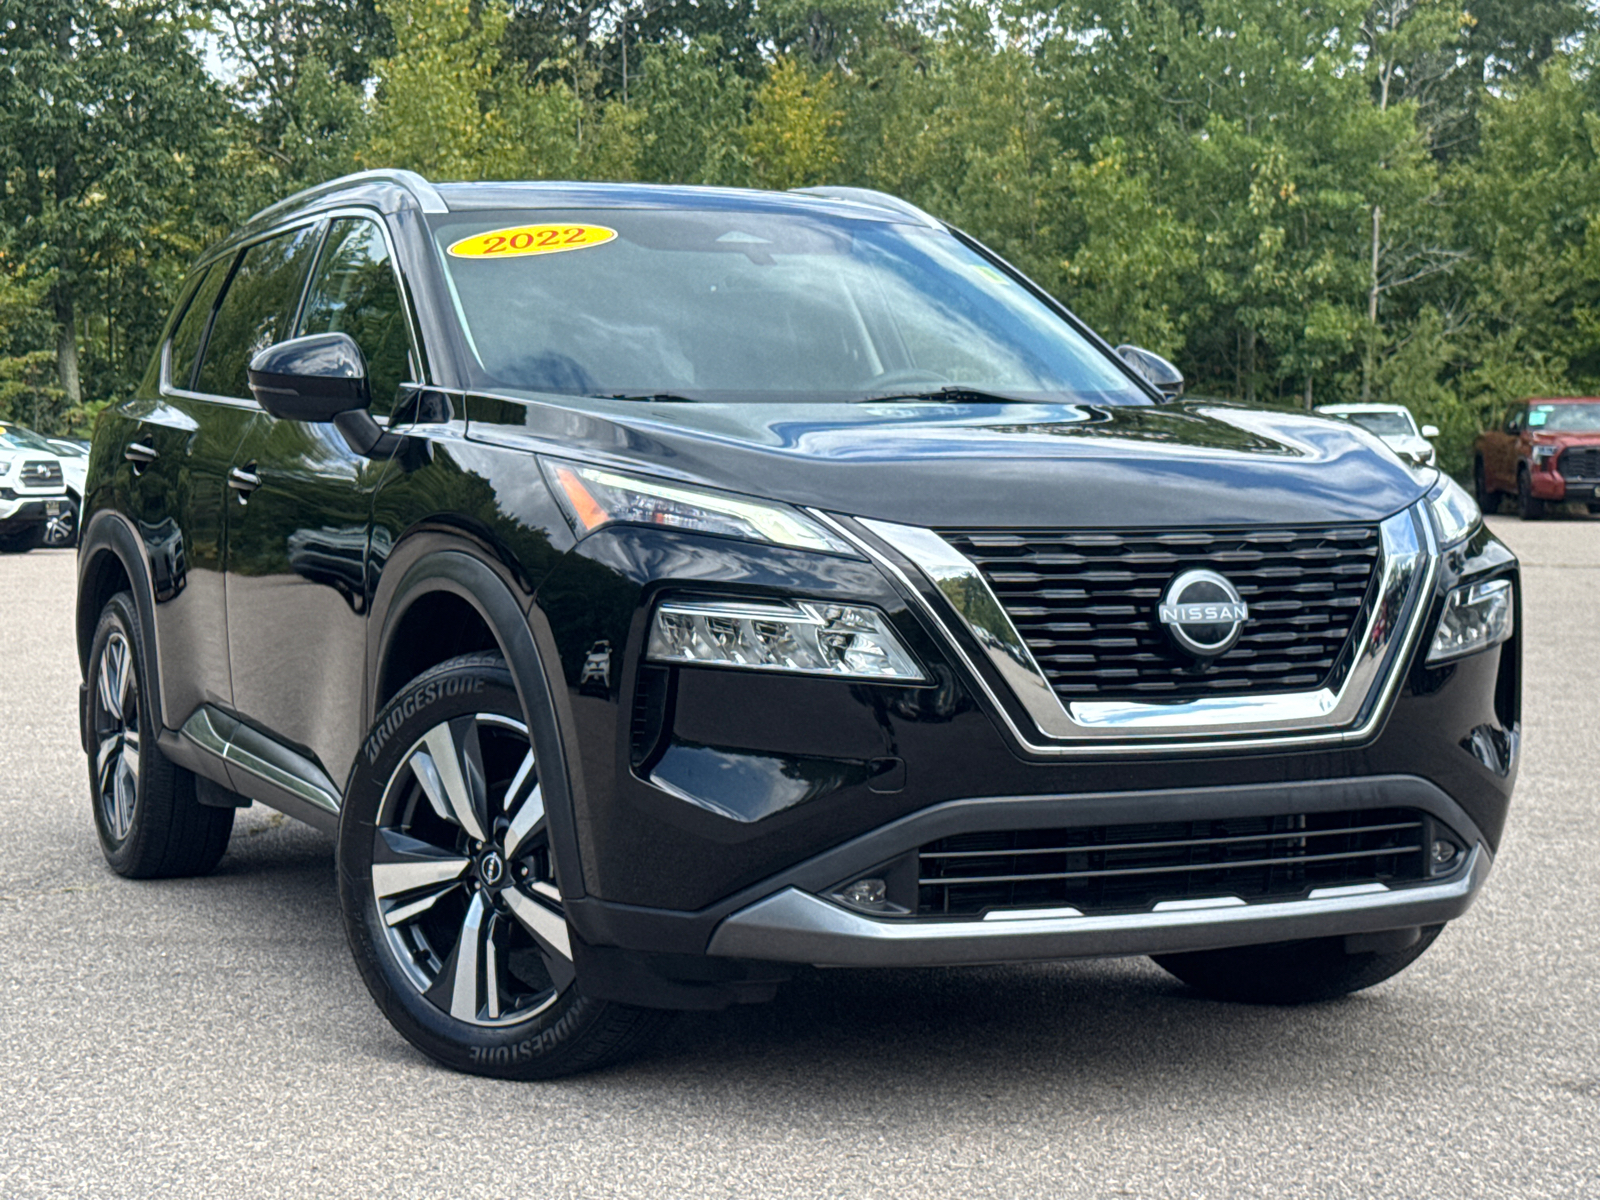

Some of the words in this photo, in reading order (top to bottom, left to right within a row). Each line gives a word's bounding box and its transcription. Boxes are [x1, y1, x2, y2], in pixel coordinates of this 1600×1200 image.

[483, 228, 586, 254] 2022
[1162, 606, 1246, 621] NISSAN
[364, 676, 485, 766] BRIDGESTONE
